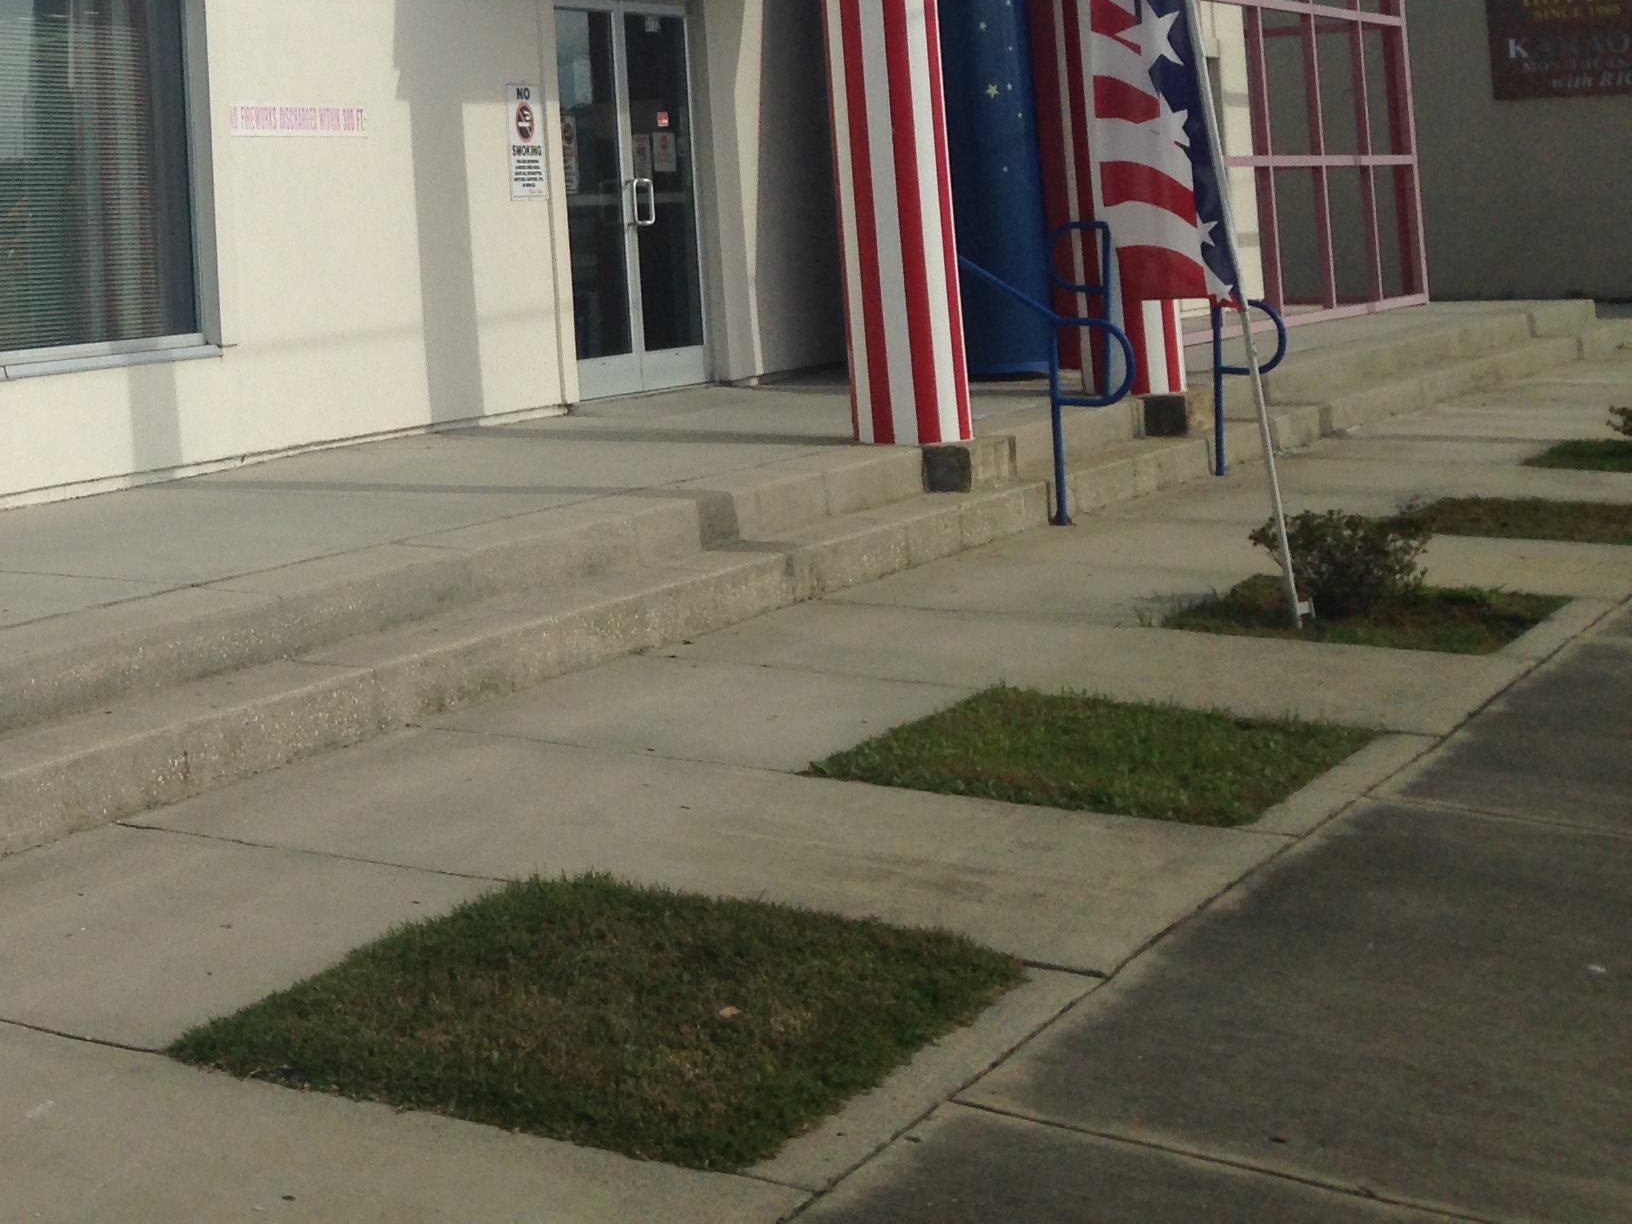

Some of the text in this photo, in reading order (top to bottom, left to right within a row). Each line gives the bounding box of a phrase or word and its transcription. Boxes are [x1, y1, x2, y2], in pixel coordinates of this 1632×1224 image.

[516, 87, 530, 100] NO
[241, 106, 277, 130] FIREWORKS
[511, 145, 542, 157] SMOKING
